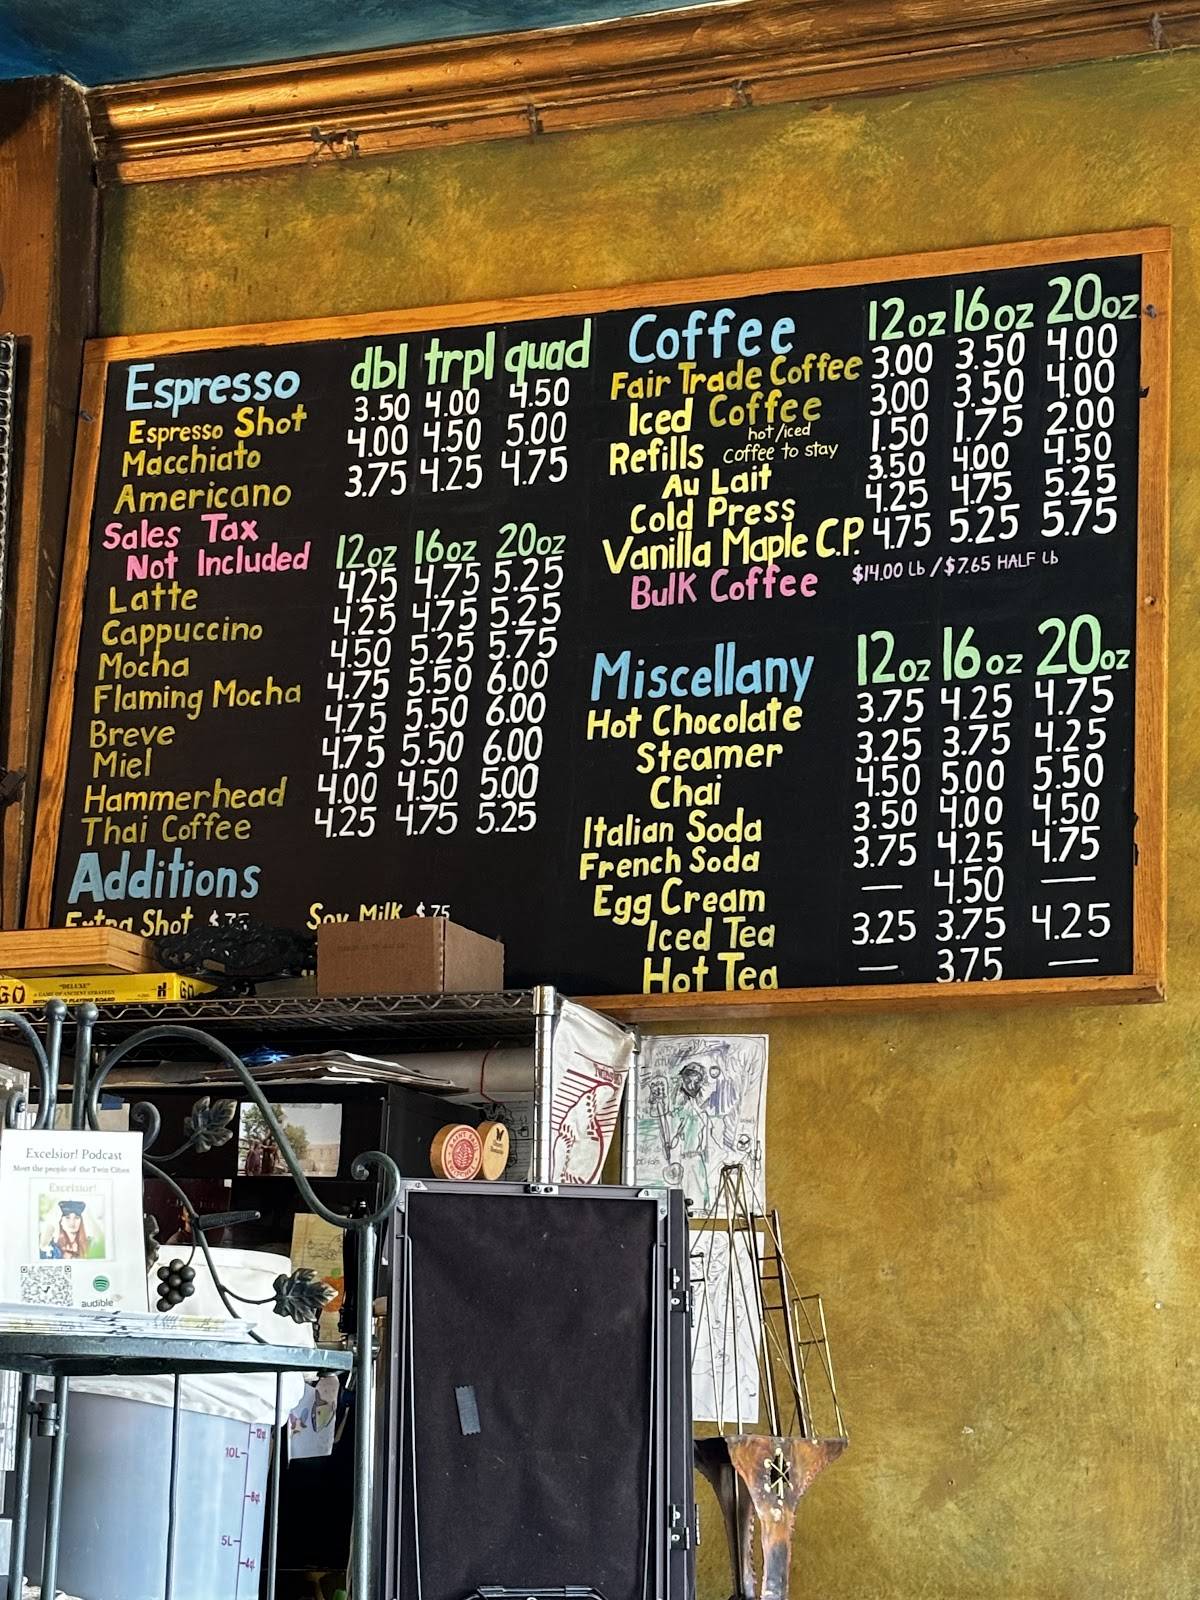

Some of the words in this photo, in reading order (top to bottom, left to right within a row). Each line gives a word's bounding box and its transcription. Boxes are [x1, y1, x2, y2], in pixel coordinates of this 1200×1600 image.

[868, 297, 947, 341] 12oz
[953, 285, 1035, 333] 16oz
[1047, 272, 1140, 325] 20oz
[350, 343, 408, 391] dbl
[424, 330, 496, 391] trpl
[504, 318, 592, 387] quad
[628, 307, 795, 364] Coffee
[871, 342, 933, 381] 3.00
[954, 331, 1026, 371] 3.50
[1047, 323, 1118, 361] 4.00
[125, 363, 301, 418] Espresso
[610, 369, 671, 401] Fair
[677, 358, 763, 395] Trade
[770, 352, 863, 385] Coffee
[869, 377, 929, 416] 3.00
[953, 367, 1025, 408] 3.50
[1047, 358, 1115, 399] 4.00
[354, 393, 410, 422] 3.50
[425, 388, 480, 418] 4.00
[509, 377, 570, 408] 4.50
[629, 397, 694, 436] Iced
[708, 389, 823, 428] Coffee
[129, 420, 223, 450] Espresso
[234, 404, 307, 438] Shot
[347, 423, 409, 458] 4.00
[423, 417, 482, 453] 4.50
[506, 411, 567, 447] 5.00
[748, 421, 811, 443] hot/iced
[871, 412, 929, 452] 1.50
[956, 404, 1024, 443] 1.75
[1046, 396, 1115, 436] 2.00
[122, 440, 261, 477] Macchiato
[609, 435, 704, 475] Refills
[781, 442, 799, 460] to
[804, 441, 839, 459] stay
[868, 450, 926, 480] 3.50
[953, 442, 1010, 472] 4.00
[1043, 430, 1113, 465] 4.50
[344, 460, 408, 498] 3.75
[420, 454, 483, 492] 4.25
[501, 446, 568, 486] 4.75
[661, 474, 699, 499] Au
[711, 463, 772, 496] Lait
[865, 479, 929, 514] 4.25
[951, 471, 1013, 506] 4.75
[1044, 463, 1117, 498] 5.25
[113, 481, 292, 515] Americano
[630, 498, 694, 534] Cold
[707, 496, 796, 528] Press
[102, 519, 181, 550] Sales
[200, 513, 259, 543] Tax
[872, 512, 932, 550] 4.75
[949, 503, 1021, 544] 5.25
[1040, 495, 1118, 537] 5.75
[126, 553, 178, 581] Not
[198, 541, 311, 577] Included
[336, 533, 398, 570] 12oz
[415, 528, 478, 564] 16oz
[496, 522, 567, 559] 20oz
[602, 530, 712, 575] Vanilla
[722, 521, 809, 567] Maple
[815, 516, 865, 559] C.P.
[338, 567, 398, 604] 4.25
[414, 562, 482, 600] 4.75
[710, 563, 819, 602] Coffee
[852, 562, 903, 585] $14.00
[997, 551, 1036, 570] HALF
[109, 582, 198, 614] Latte
[101, 616, 263, 656] Cappuccino
[330, 637, 392, 669] 4.50
[410, 631, 474, 666] 5.25
[488, 626, 558, 660] 5.75
[857, 630, 932, 686] 12oz
[1036, 613, 1131, 676] 20oz
[97, 650, 190, 680] Mocha
[326, 668, 390, 701] 4.75
[407, 663, 473, 696] 5.50
[591, 641, 815, 701] Miscellany
[94, 684, 203, 720] Flaming
[212, 676, 301, 708] Mocha
[325, 701, 387, 734] 4.75
[404, 694, 469, 732] 5.50
[857, 688, 924, 723] 3.75
[941, 683, 1013, 721] 4.25
[1035, 675, 1114, 716] 4.75
[89, 719, 176, 748] Breve
[586, 706, 643, 741] Hot
[652, 697, 803, 737] Chocolate
[636, 740, 783, 774] Steamer
[855, 727, 923, 764] 3.25
[943, 722, 1012, 758] 3.75
[1035, 718, 1107, 753] 4.25
[92, 747, 152, 779] Miel
[856, 763, 921, 797] 4.50
[941, 759, 1005, 795] 5.00
[1033, 753, 1104, 791] 5.50
[84, 776, 288, 813] Hammerhead
[318, 772, 377, 805] 4.00
[397, 766, 458, 802] 4.50
[650, 774, 723, 810] Chai
[81, 814, 148, 846] Thai
[162, 812, 251, 842] Coffee
[314, 805, 377, 838] 4.25
[395, 801, 459, 836] 4.75
[475, 800, 537, 834] 5.25
[583, 814, 674, 849] Italian
[686, 807, 763, 844] Soda
[853, 798, 918, 832] 3.50
[939, 796, 1003, 829] 4.00
[579, 846, 682, 881] French
[689, 844, 760, 874] Soda
[853, 832, 917, 869] 3.75
[938, 831, 1004, 865] 4.25
[67, 847, 261, 904] Additions
[934, 865, 1004, 904] 4.50
[140, 905, 194, 938] Shot
[593, 884, 652, 926] Egg
[661, 877, 766, 915] Cream
[647, 917, 712, 952] Iced
[723, 916, 776, 949] Tea
[852, 909, 916, 946] 3.25
[935, 906, 1006, 942] 3.75
[1031, 902, 1111, 941] 4.25
[643, 955, 709, 994] Hot
[717, 952, 779, 991] Tea
[936, 947, 1003, 983] 3.75
[26, 1147, 78, 1159] Excelsior!
[82, 1149, 122, 1160] Podcast
[49, 1183, 97, 1193] Excelsior!
[81, 1298, 114, 1308] audible
[225, 1447, 240, 1458] 10L
[221, 1535, 233, 1546] 5L
